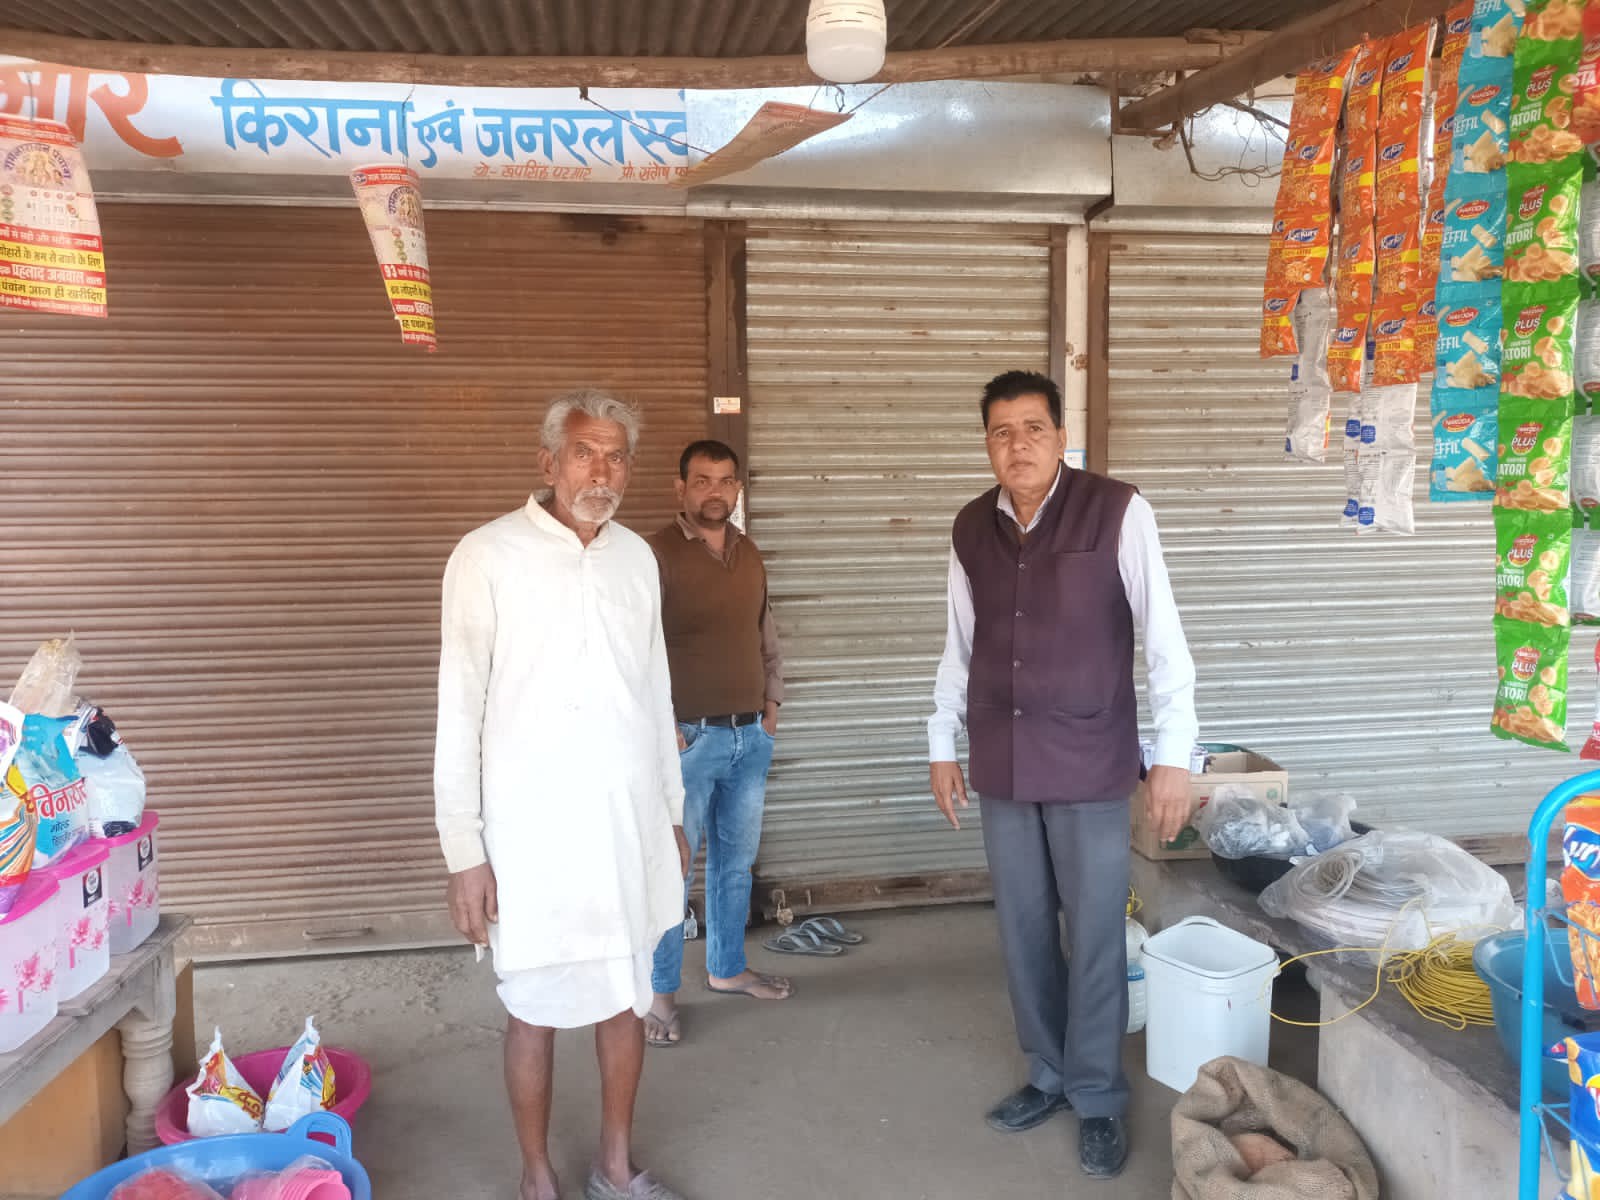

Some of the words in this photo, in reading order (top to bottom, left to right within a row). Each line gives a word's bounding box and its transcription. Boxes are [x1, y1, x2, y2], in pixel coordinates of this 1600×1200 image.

[412, 99, 464, 168] एवं
[472, 108, 632, 165] जनरल
[1520, 198, 1543, 211] PLUS
[1515, 319, 1540, 329] PLUS
[1512, 435, 1537, 447] PLUS
[1512, 661, 1537, 672] PLUS
